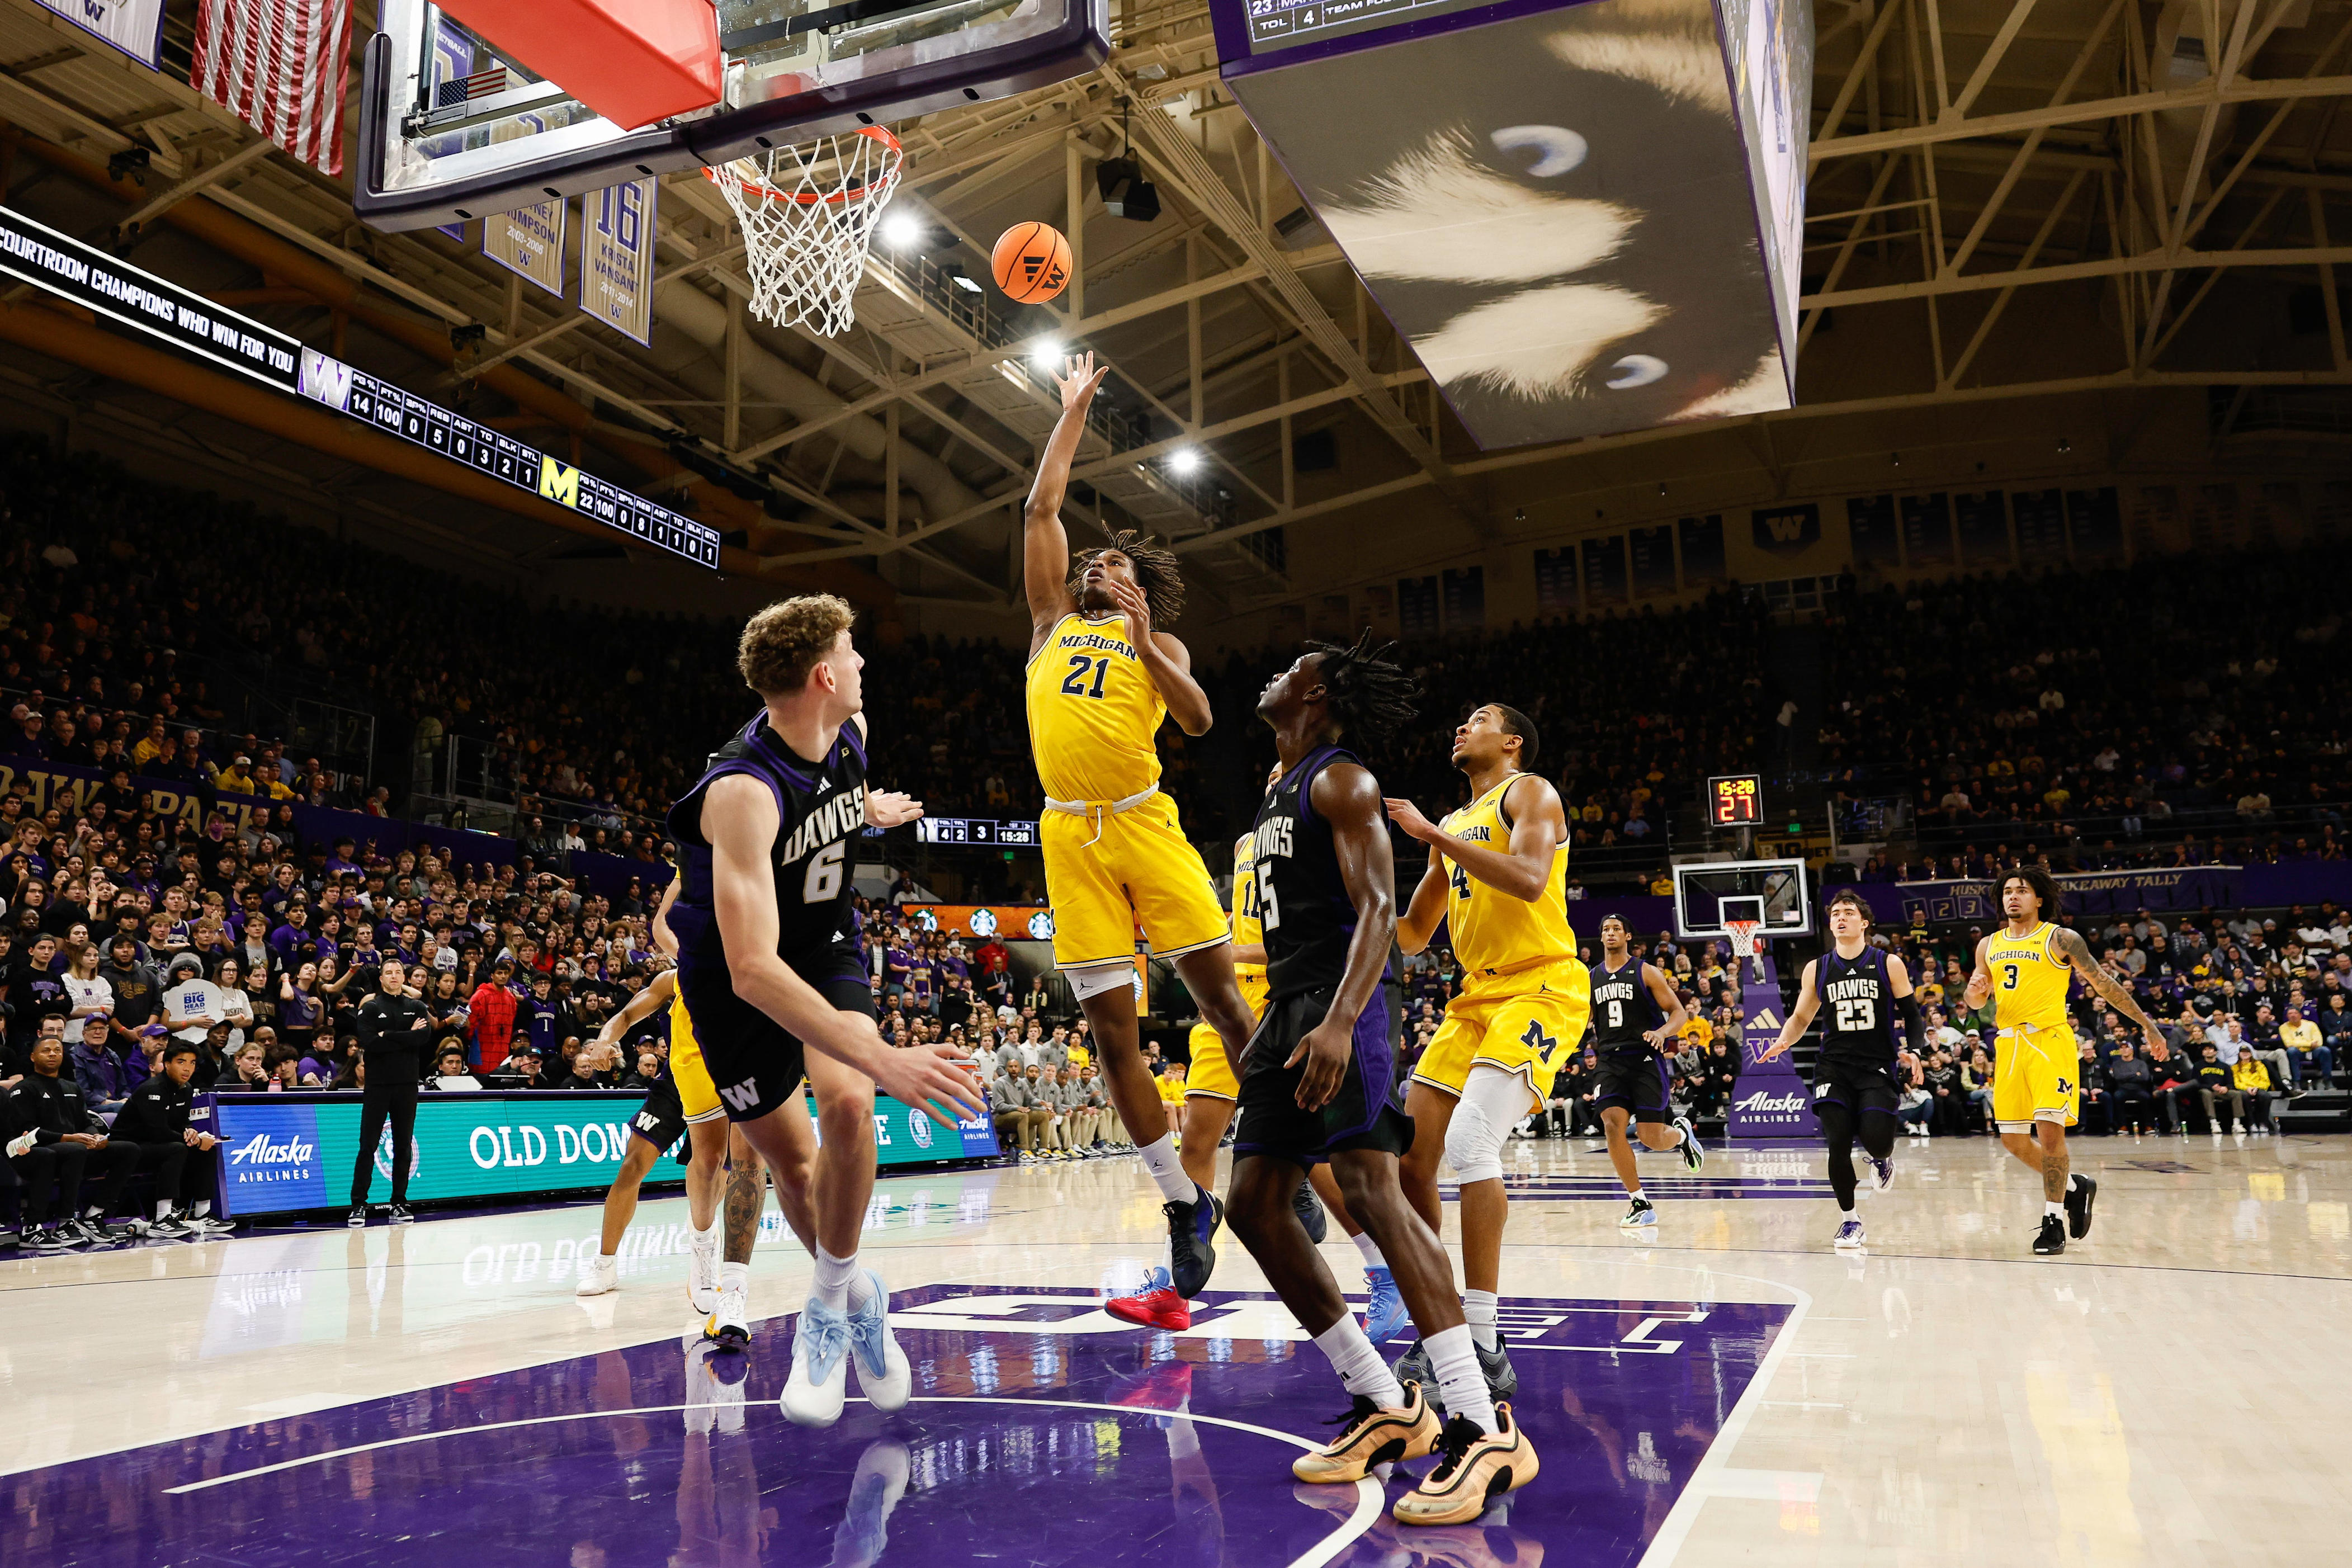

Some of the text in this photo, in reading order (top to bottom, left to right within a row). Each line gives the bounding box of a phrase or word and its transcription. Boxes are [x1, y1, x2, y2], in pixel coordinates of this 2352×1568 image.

[1260, 18, 1288, 30] TOL
[1303, 10, 1315, 25] 4
[1325, 1, 1363, 15] TEAM
[518, 249, 532, 266] W
[602, 243, 635, 274] KRISTA
[595, 258, 639, 295] VANSANT
[1042, 263, 1066, 290] W
[600, 281, 634, 308] 2011-2014
[91, 268, 175, 322] CHAMPIONS
[178, 306, 210, 337] WHO
[212, 320, 238, 350] WIN
[240, 334, 265, 361] FOR
[268, 346, 294, 373] YOU
[610, 304, 622, 319] W
[353, 393, 531, 483] 14 100 0 5 0 3 2 1
[430, 408, 450, 423] REB
[454, 419, 473, 432] AST
[480, 430, 493, 441] TO
[499, 438, 517, 452] BLK
[522, 449, 537, 462] STL
[540, 456, 579, 508] M
[579, 492, 712, 560] 22 100 0 8 1 1 0 1
[654, 509, 668, 519] AST
[673, 517, 683, 527] TO
[687, 523, 701, 535] BLK
[705, 531, 717, 542] STL
[1765, 514, 1806, 542] W
[1058, 634, 1137, 662] MICHIGAN
[1060, 654, 1111, 700] 21
[1718, 780, 1755, 796] 15:28
[1718, 795, 1754, 821] 27
[782, 785, 865, 866] DAWGS
[941, 825, 1029, 843] 4 2 3 15:28
[802, 839, 846, 904] 6
[1452, 863, 1472, 901] 4
[1950, 873, 2182, 896] HUSK AKEAWAY TALLY
[1257, 860, 1280, 932] 5
[1938, 900, 1977, 917] 2 3
[1990, 950, 2041, 965] MICHIGAN
[1826, 979, 1879, 1003] DAWGS
[2004, 964, 2019, 990] 3
[184, 994, 205, 1004] BIG
[1594, 983, 1633, 1005] DAWGS
[544, 1019, 549, 1032] 1
[1608, 1000, 1623, 1028] 9
[1835, 998, 1876, 1032] 23
[1520, 1018, 1557, 1065] M
[720, 1076, 761, 1112] W
[1734, 1091, 1806, 1113] Alaska
[1816, 1083, 1831, 1099] W
[2057, 1078, 2073, 1098] M
[635, 1111, 660, 1132] W
[1740, 1114, 1801, 1123] AIRLINES
[230, 1134, 314, 1166] Alaska
[470, 1125, 547, 1169] OLD
[239, 1169, 310, 1183] AIRLINES
